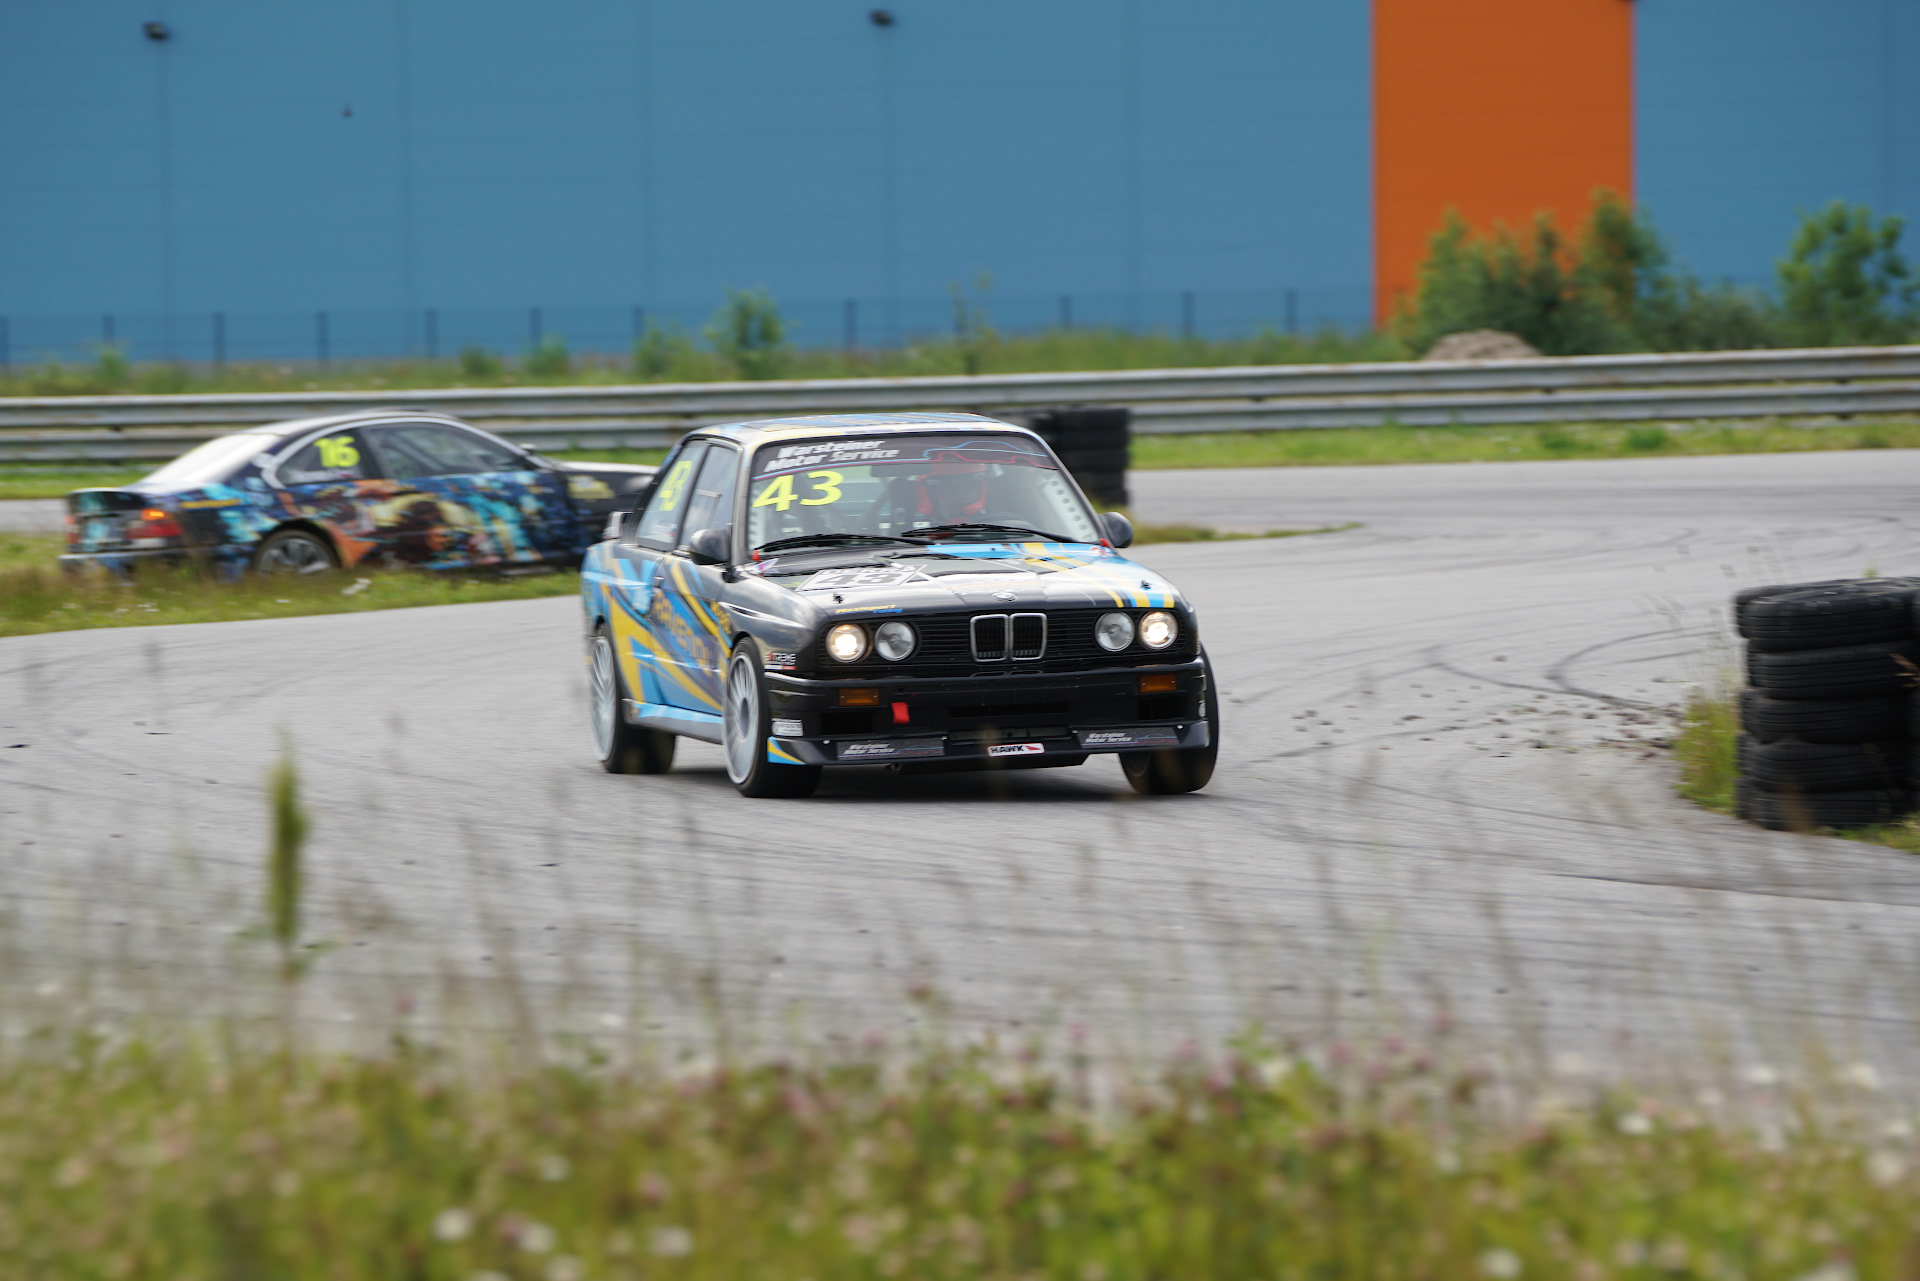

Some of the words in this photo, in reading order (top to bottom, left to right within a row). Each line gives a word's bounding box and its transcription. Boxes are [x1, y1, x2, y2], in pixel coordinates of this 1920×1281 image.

[313, 435, 360, 468] 16
[763, 454, 828, 473] Motor
[829, 448, 900, 462] Service
[777, 440, 886, 459] Warsteiner
[658, 460, 693, 512] 43
[751, 470, 844, 512] 43
[815, 573, 903, 586] 43
[990, 744, 1025, 754] HAWK
